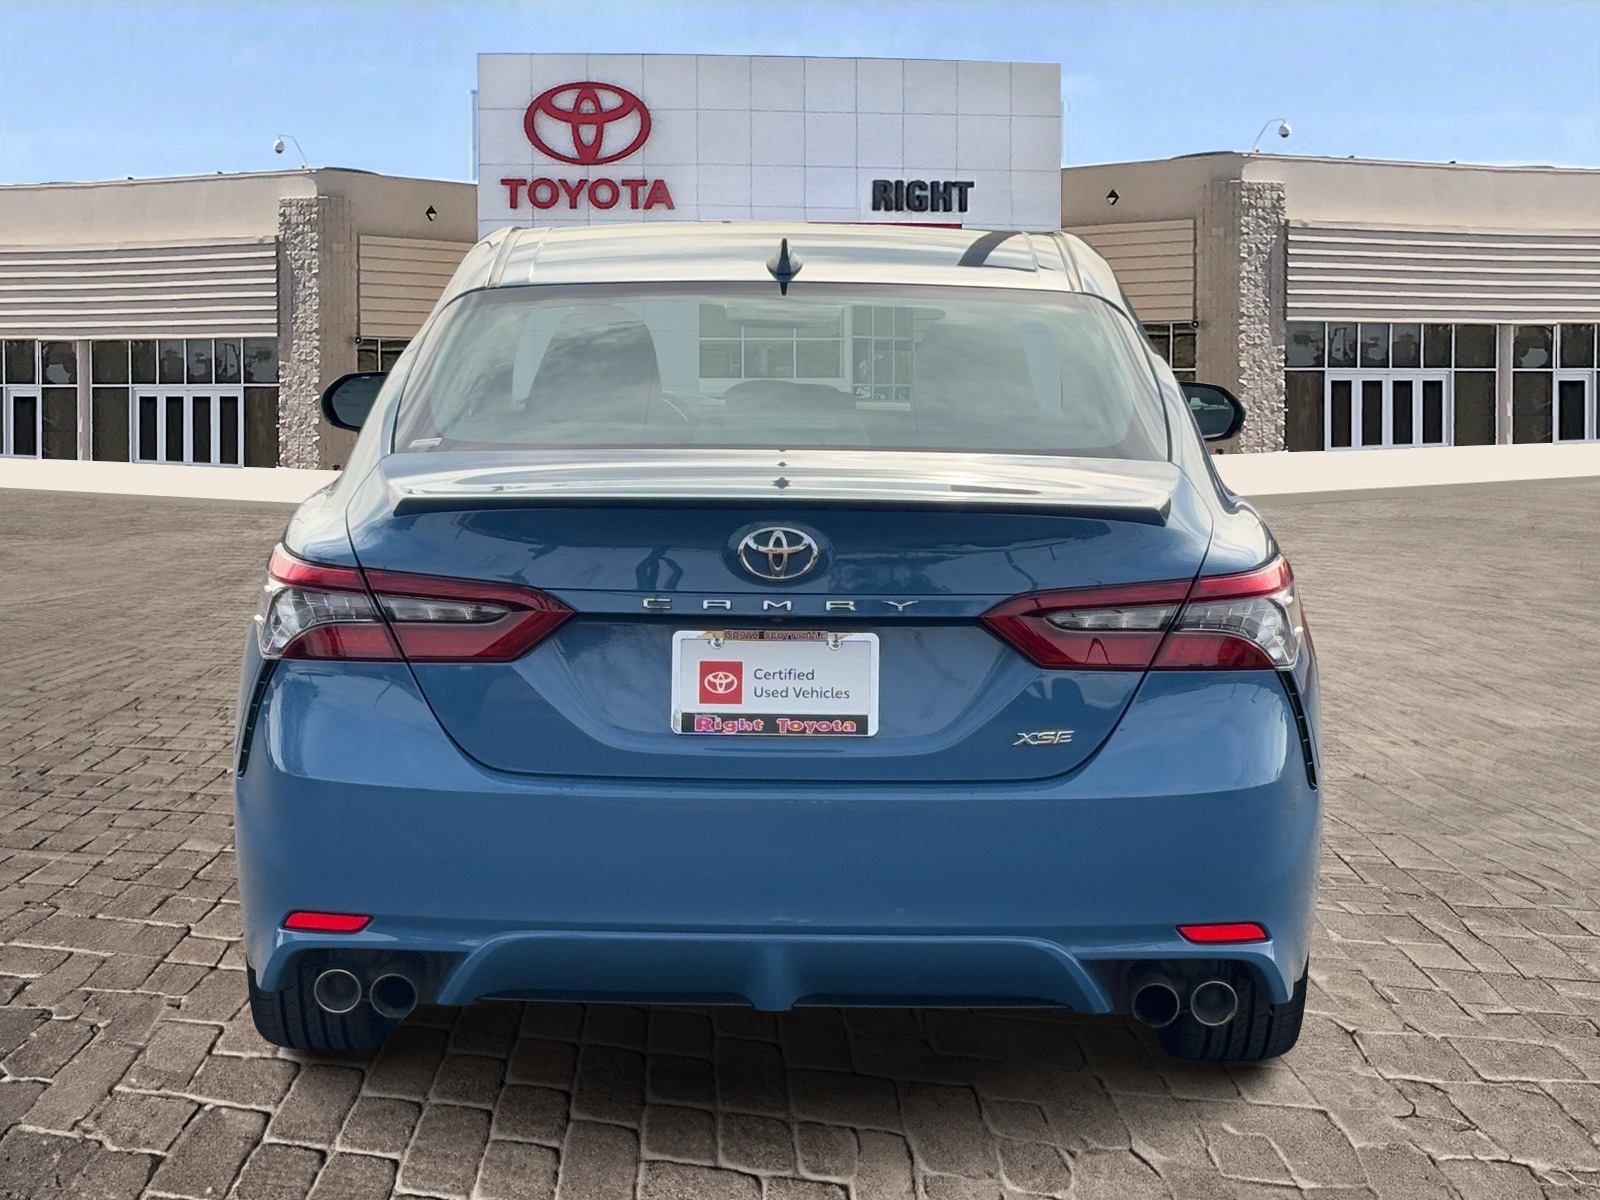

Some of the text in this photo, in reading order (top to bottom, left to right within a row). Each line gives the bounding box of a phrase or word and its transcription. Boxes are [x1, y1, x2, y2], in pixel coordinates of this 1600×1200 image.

[500, 178, 675, 210] TOYOTA
[871, 179, 975, 213] RIGHT
[642, 597, 919, 612] CAMRY
[753, 668, 815, 681] Certified
[753, 685, 850, 700] Used Vehicles
[694, 716, 857, 734] Right Toyota
[1012, 730, 1075, 746] XSE
